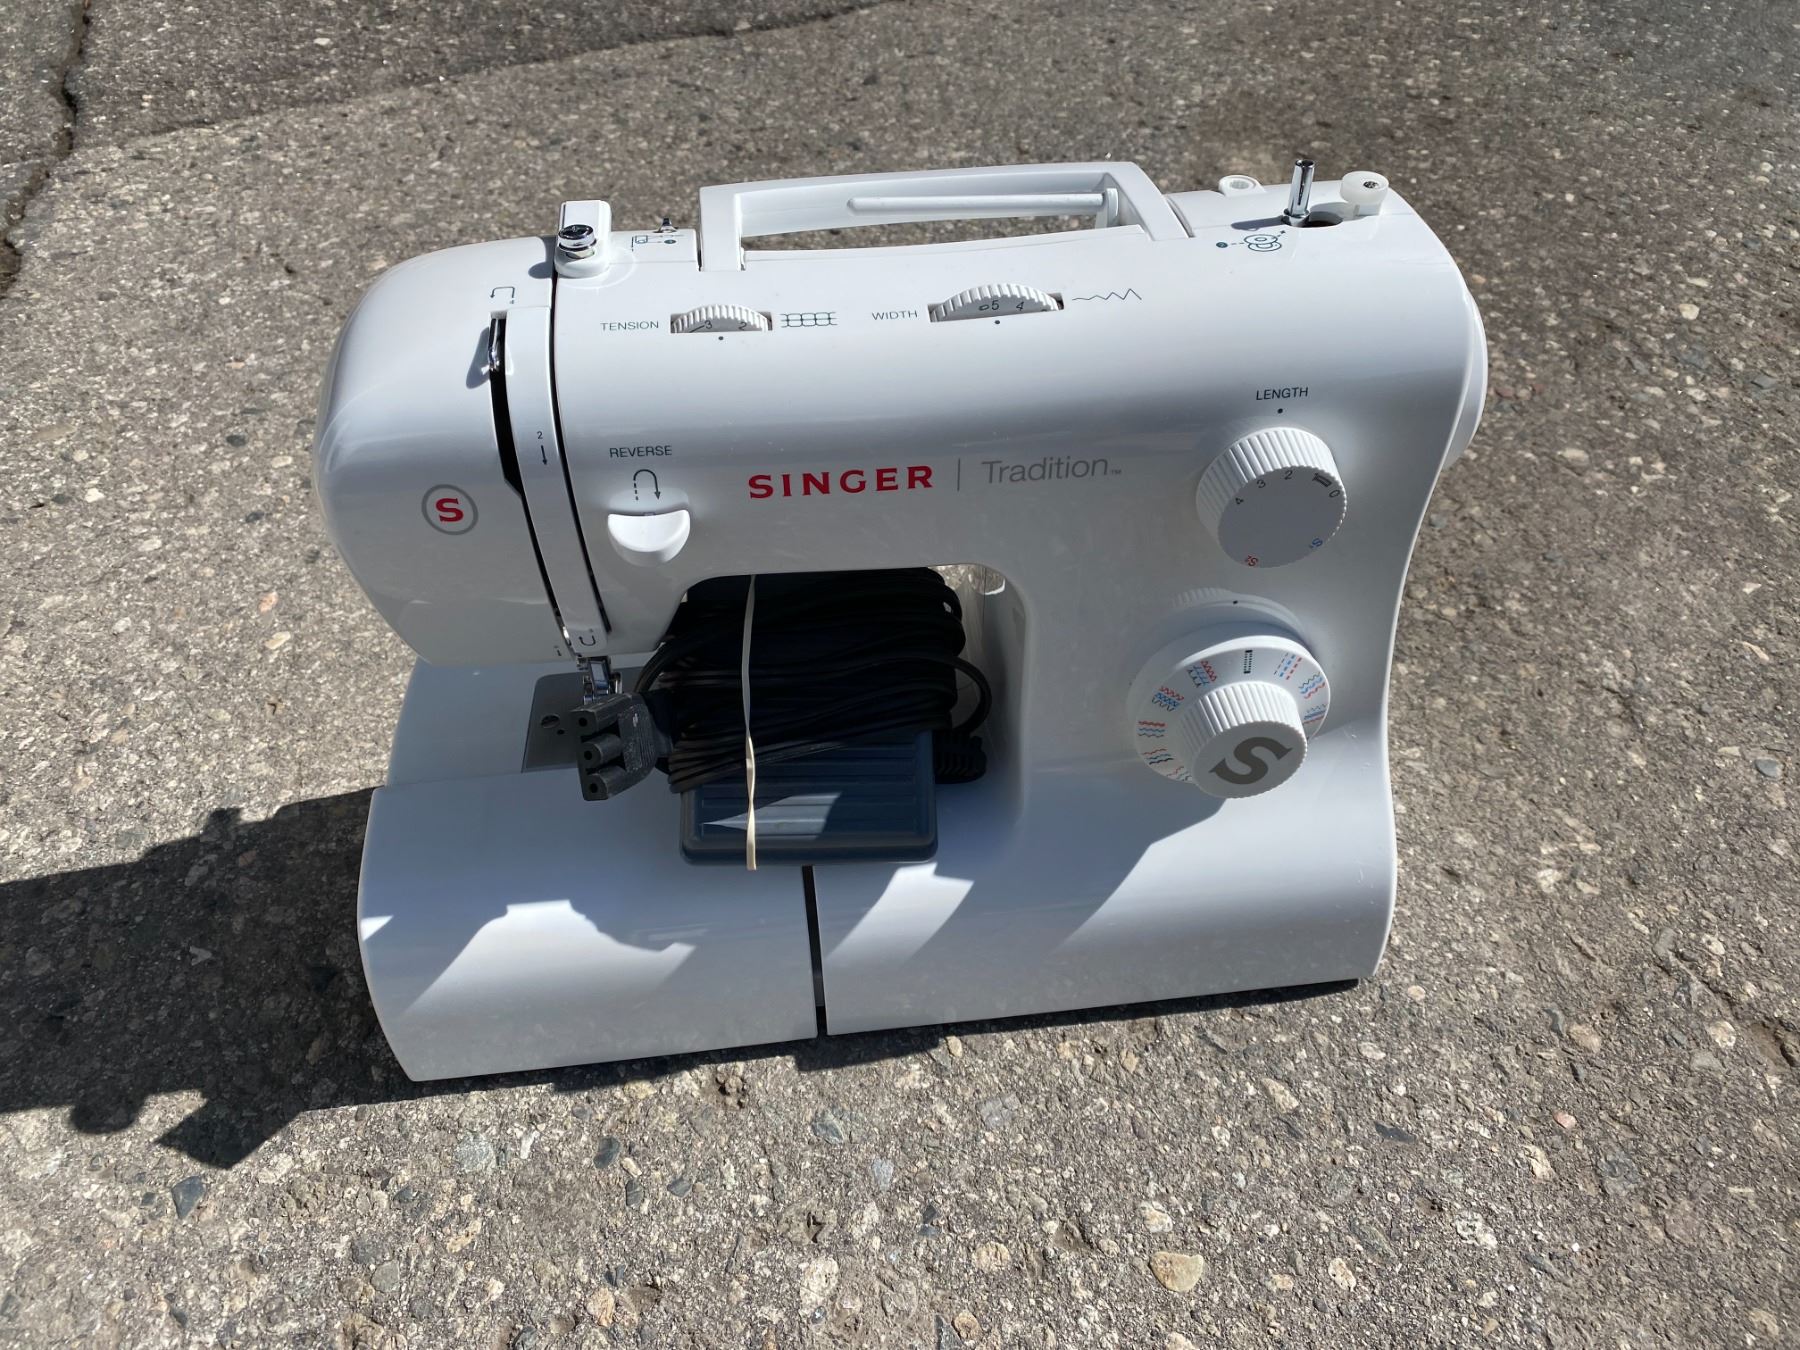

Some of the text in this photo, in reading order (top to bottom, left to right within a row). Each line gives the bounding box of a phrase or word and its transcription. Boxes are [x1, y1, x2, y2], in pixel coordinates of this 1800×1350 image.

[1015, 301, 1025, 312] 4
[871, 310, 918, 321] WIDTH
[600, 320, 659, 332] TENSION
[703, 319, 748, 331] 3 2
[1255, 386, 1309, 401] LENGTH
[536, 430, 543, 440] 2
[609, 445, 673, 459] REVERSE
[747, 465, 934, 499] SINGER
[1256, 479, 1266, 489] 3
[1284, 469, 1294, 480] 2
[435, 497, 464, 523] S
[1208, 736, 1294, 785] S
